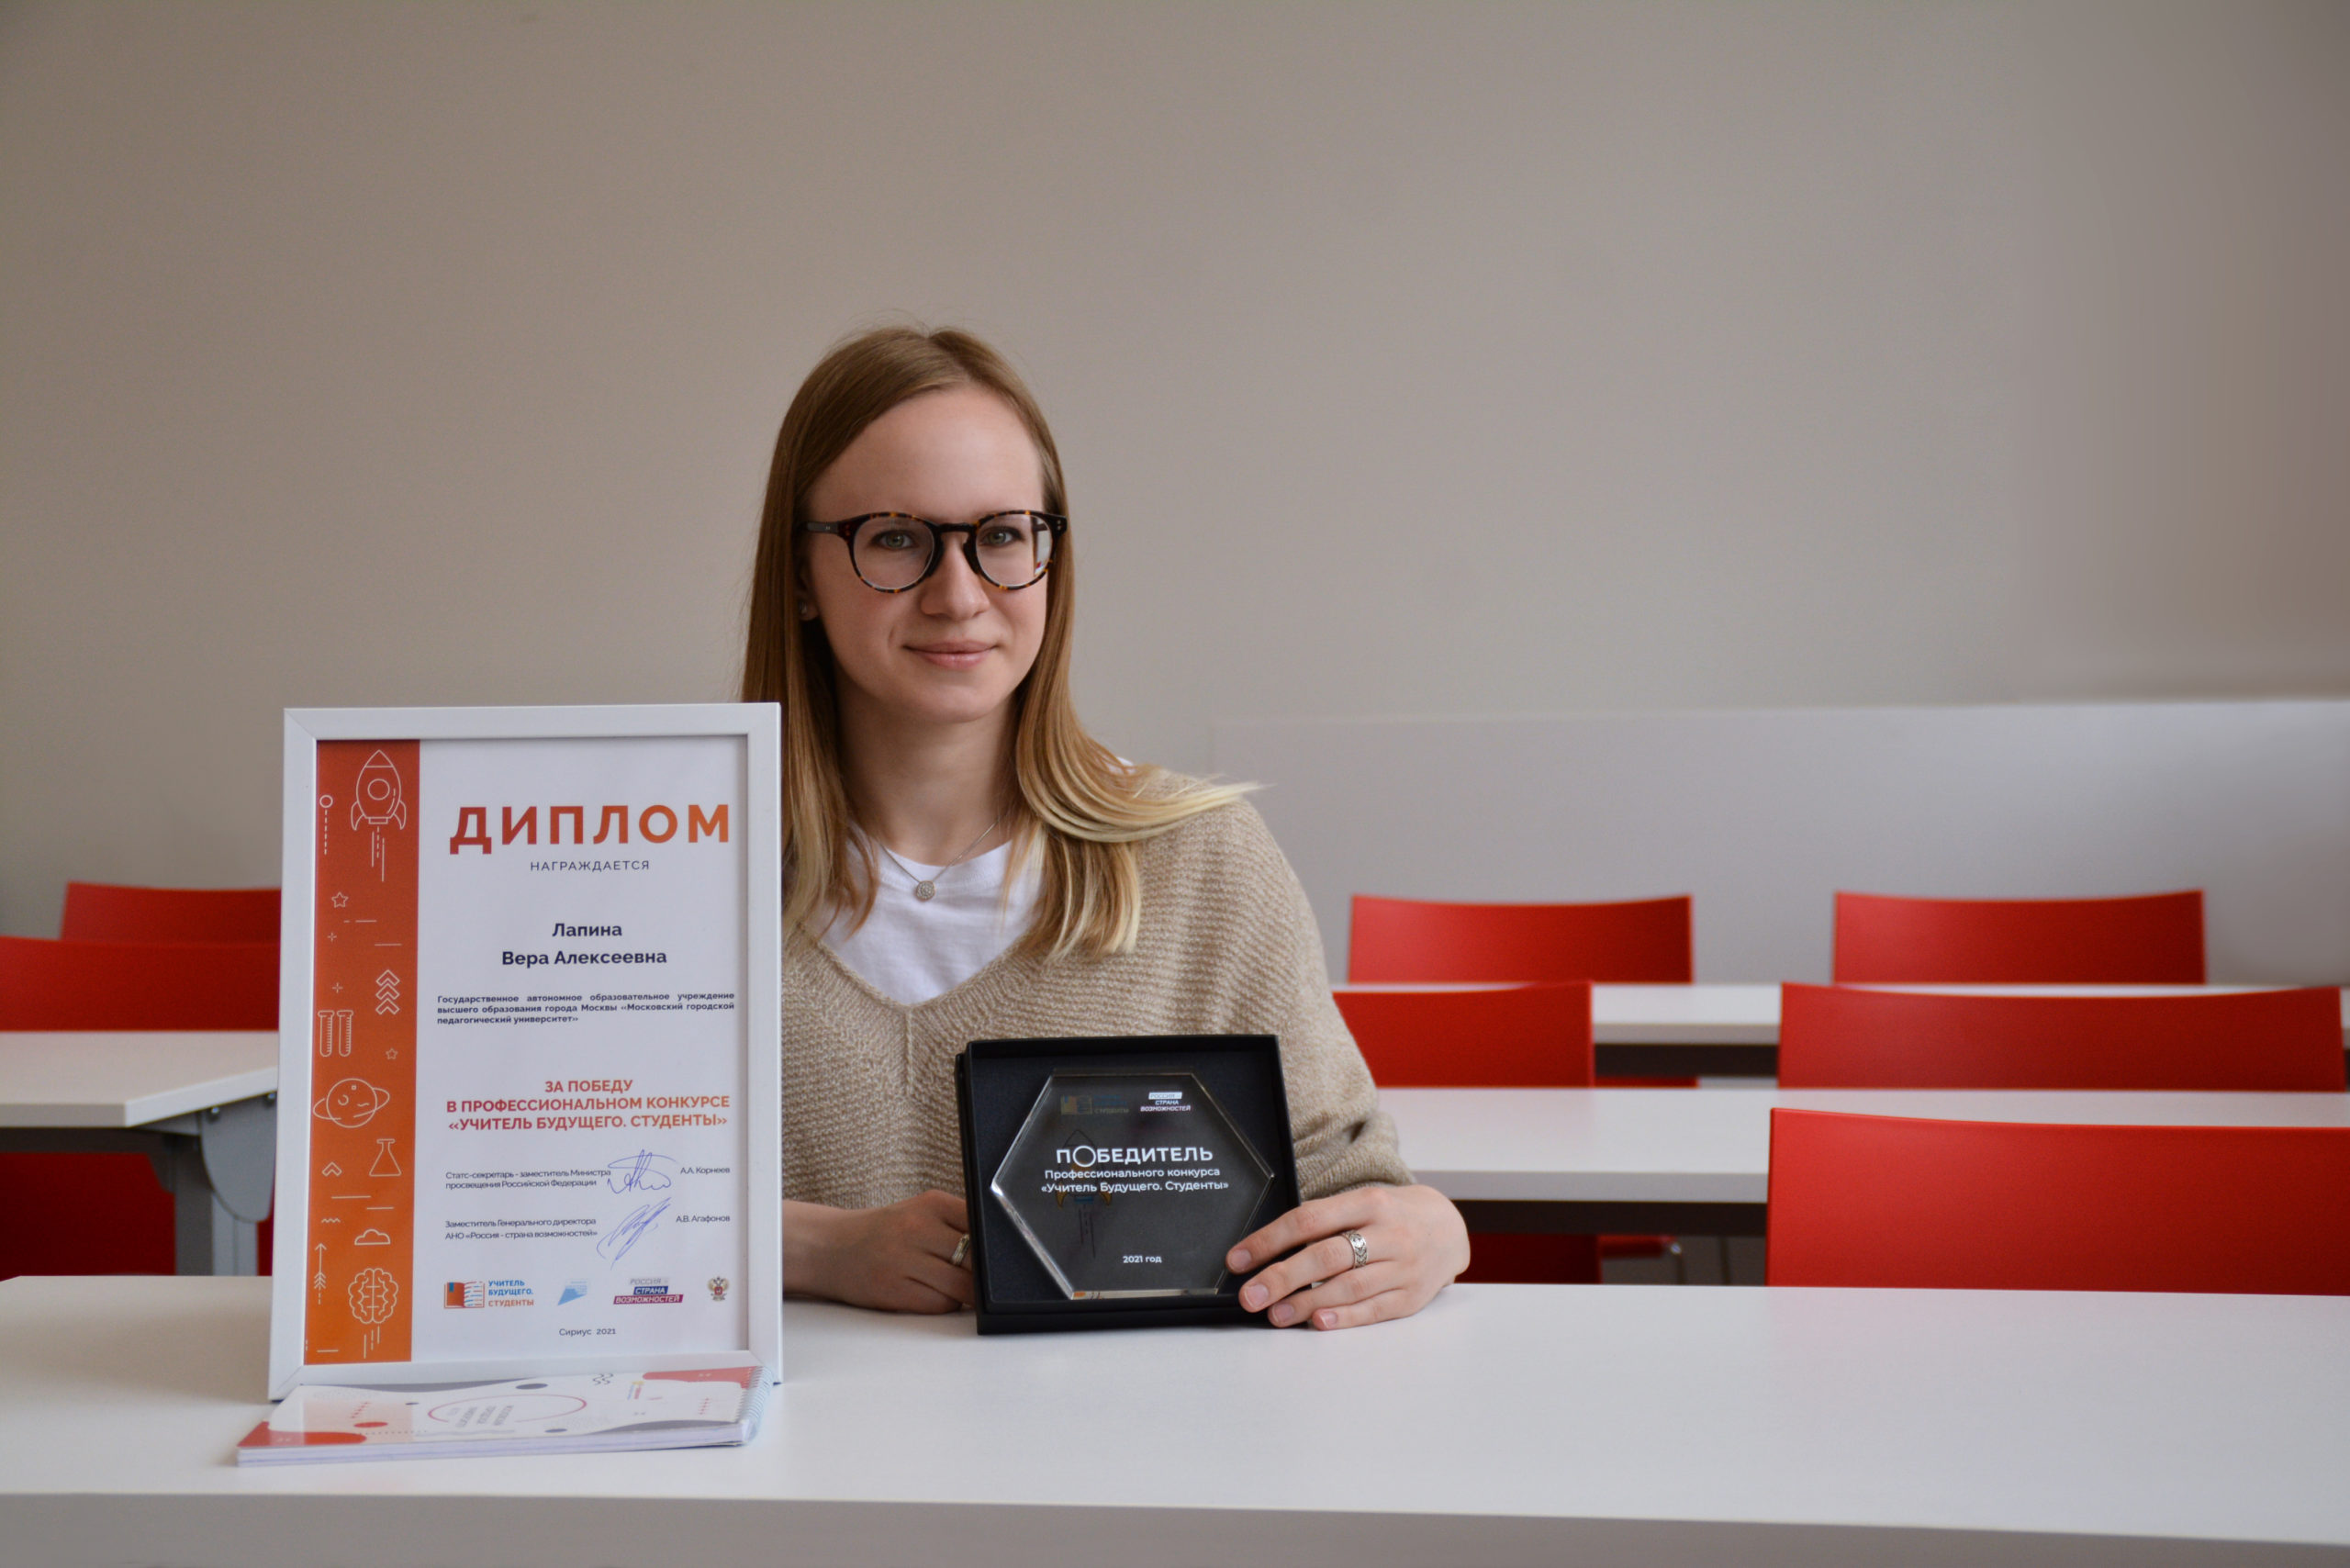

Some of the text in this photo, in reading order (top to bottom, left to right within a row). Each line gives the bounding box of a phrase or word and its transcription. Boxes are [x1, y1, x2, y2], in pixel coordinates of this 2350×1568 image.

[450, 804, 729, 855] ДИПЛОМ
[531, 861, 650, 872] НАГРАЖДАЕТСЯ
[552, 923, 622, 937] Лапина
[502, 950, 666, 968] Вера Алексеевна
[438, 994, 519, 1004] Государственное
[590, 993, 669, 1002] образовательное
[677, 992, 734, 1002] учреждение
[438, 1002, 734, 1014] высшего образования города Москвы «Московский городской
[438, 1015, 578, 1025] педагогический университет»
[545, 1080, 632, 1093] ЗА ПОБЕДУ
[447, 1096, 730, 1114] В ПРОФЕССИОНАЛЬНОМ КОНКУРСЕ
[449, 1114, 727, 1131] «УЧИТЕЛЬ БУДУЩЕГО. СТУДЕНТЫ»
[1057, 1145, 1214, 1167] ПОБЕДИТЕЛЬ
[446, 1171, 514, 1180] Статс-секретарь
[571, 1170, 611, 1178] Министра
[696, 1167, 730, 1175] Корнеев
[1045, 1168, 1220, 1180] Профессионального конкурса
[446, 1179, 597, 1190] просвещения Российской Федерации
[1041, 1180, 1228, 1193] «Учитель Будущего. Студенты»
[498, 1219, 552, 1227] Генерального
[553, 1218, 596, 1226] директора
[465, 1231, 499, 1239] «Россия
[1123, 1255, 1162, 1264] 2021 год
[488, 1279, 525, 1288] УЧИТЕЛЬ
[488, 1287, 534, 1297] БУДУЩЕГО.
[634, 1286, 666, 1294] СТРАНА
[488, 1298, 534, 1307] СТУДЕНТЫ
[615, 1294, 681, 1305] ВОЗМОЖНОСТЕЙ
[559, 1327, 592, 1338] Сириус
